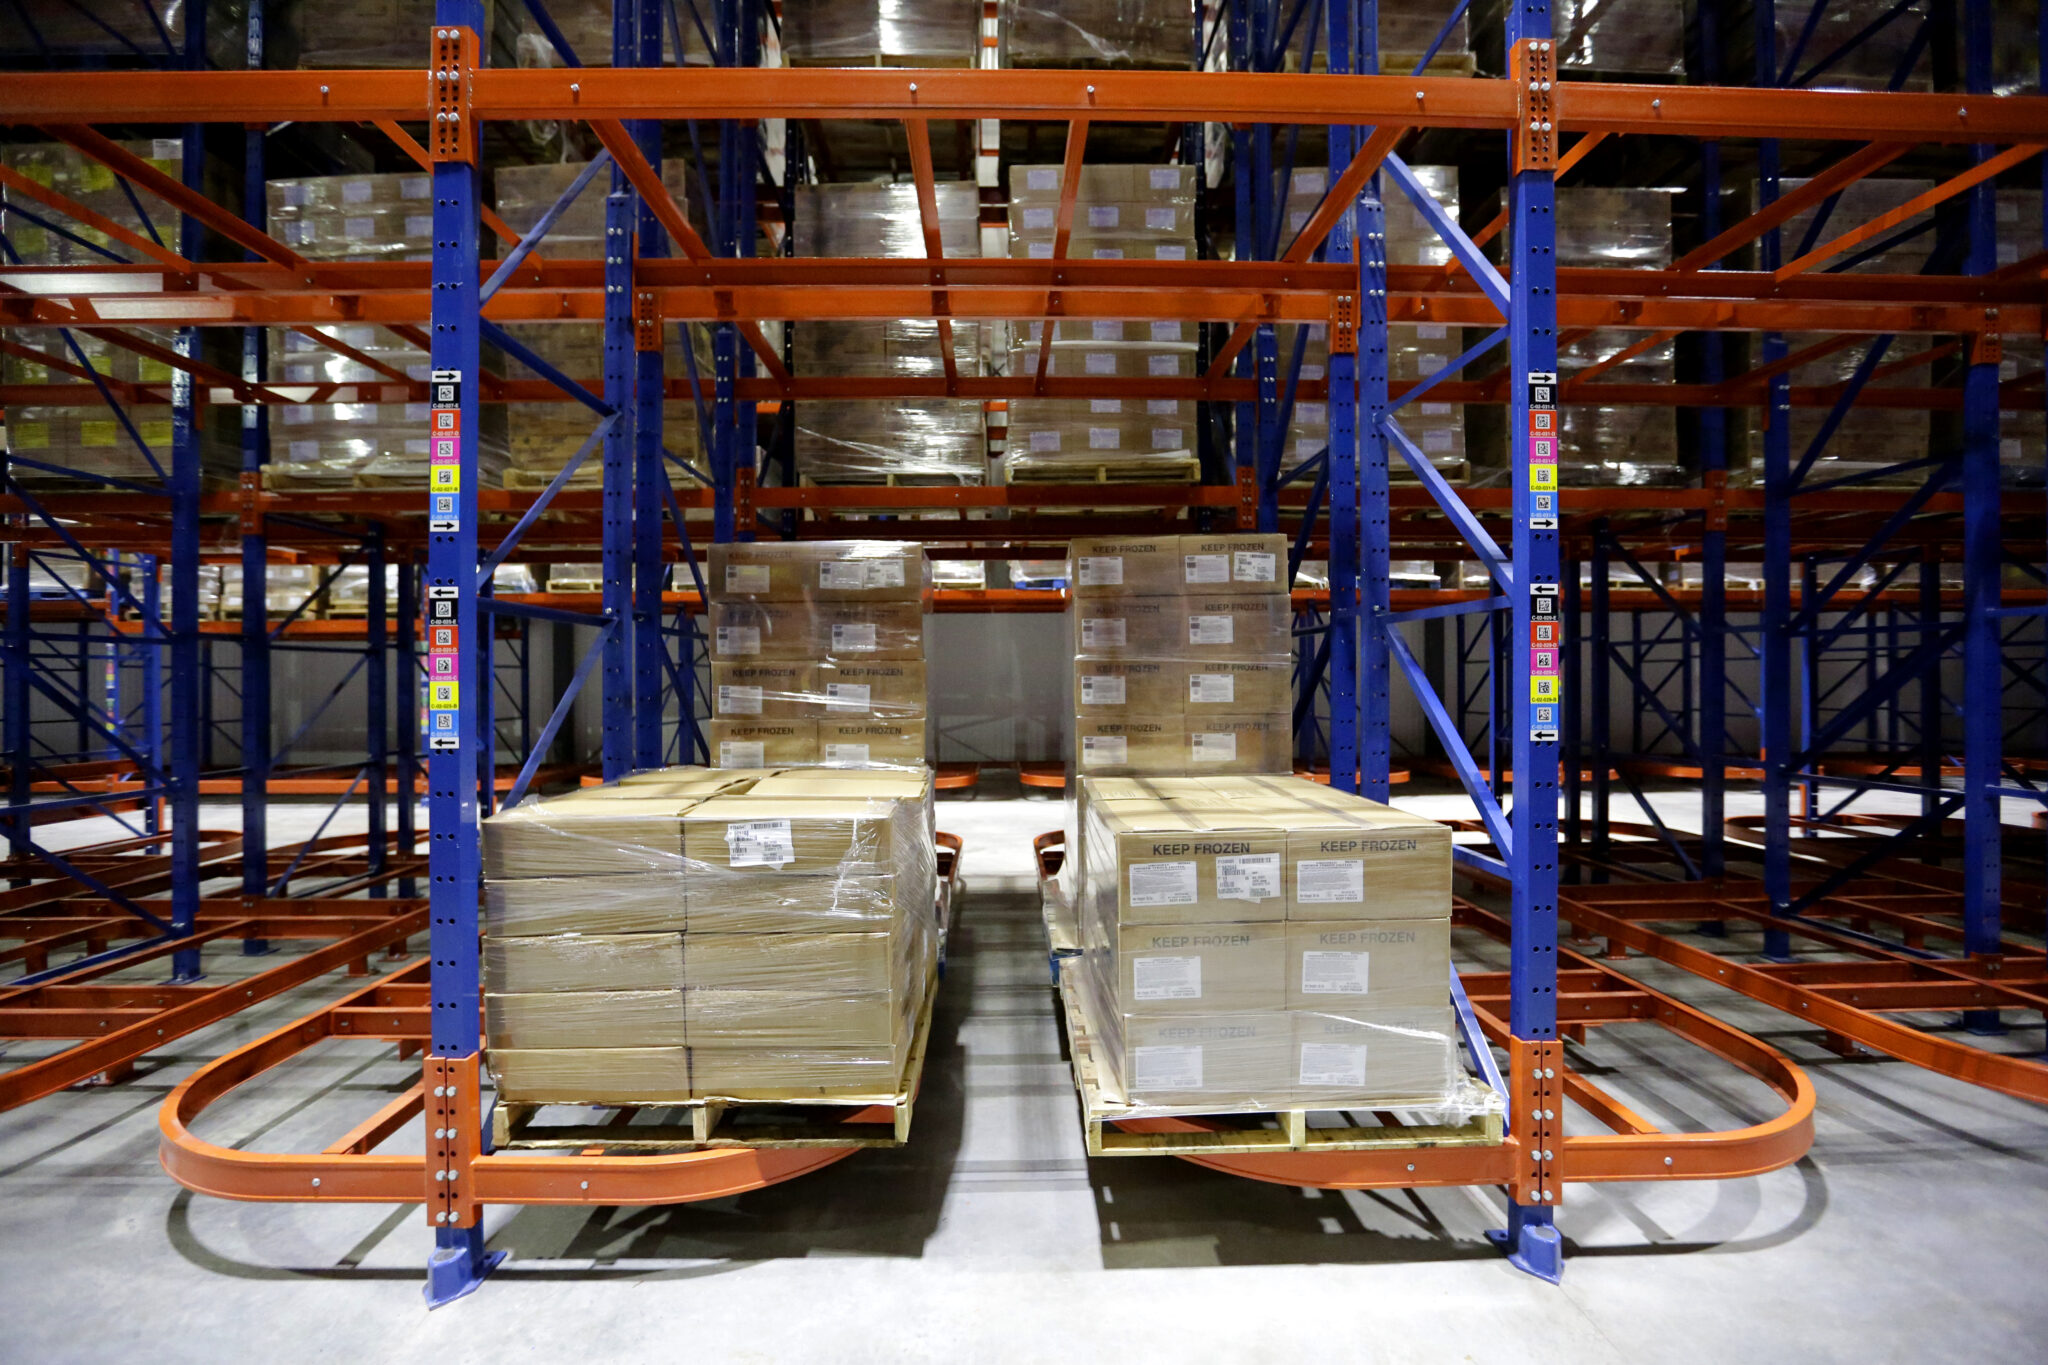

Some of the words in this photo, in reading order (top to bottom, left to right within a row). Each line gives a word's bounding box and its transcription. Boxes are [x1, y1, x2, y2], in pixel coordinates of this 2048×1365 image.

[1092, 545, 1117, 553] KEEP
[1119, 544, 1156, 552] FROZEN
[1201, 543, 1226, 552] KEEP
[1228, 543, 1264, 551] FROZEN
[1205, 603, 1229, 611] KEEP
[1232, 603, 1268, 611] FROZEN
[1096, 664, 1120, 673] KEEP
[1123, 664, 1160, 673] FROZEN
[1231, 663, 1268, 671] FROZEN
[732, 669, 757, 677] KEEP
[759, 669, 796, 677] FROZEN
[840, 668, 864, 677] KEEP
[866, 668, 903, 676] FROZEN
[731, 727, 755, 735] KEEP
[757, 727, 794, 735] FROZEN
[839, 727, 863, 735] KEEP
[865, 727, 902, 735] FROZEN
[1097, 724, 1122, 732] KEEP
[1124, 724, 1161, 732] FROZEN
[1206, 723, 1230, 731] KEEP
[1232, 722, 1270, 730] FROZEN
[1153, 843, 1191, 856] KEEP
[1194, 842, 1251, 854] FROZEN
[1320, 841, 1357, 853] KEEP
[1361, 839, 1417, 852] FROZEN
[1152, 936, 1189, 948] KEEP
[1193, 935, 1250, 947] FROZEN
[1320, 932, 1356, 944] KEEP
[1360, 931, 1415, 944] FROZEN
[1158, 1027, 1196, 1039] KEEP
[1200, 1026, 1256, 1038] FROZEN
[1324, 1022, 1362, 1035] KEEP
